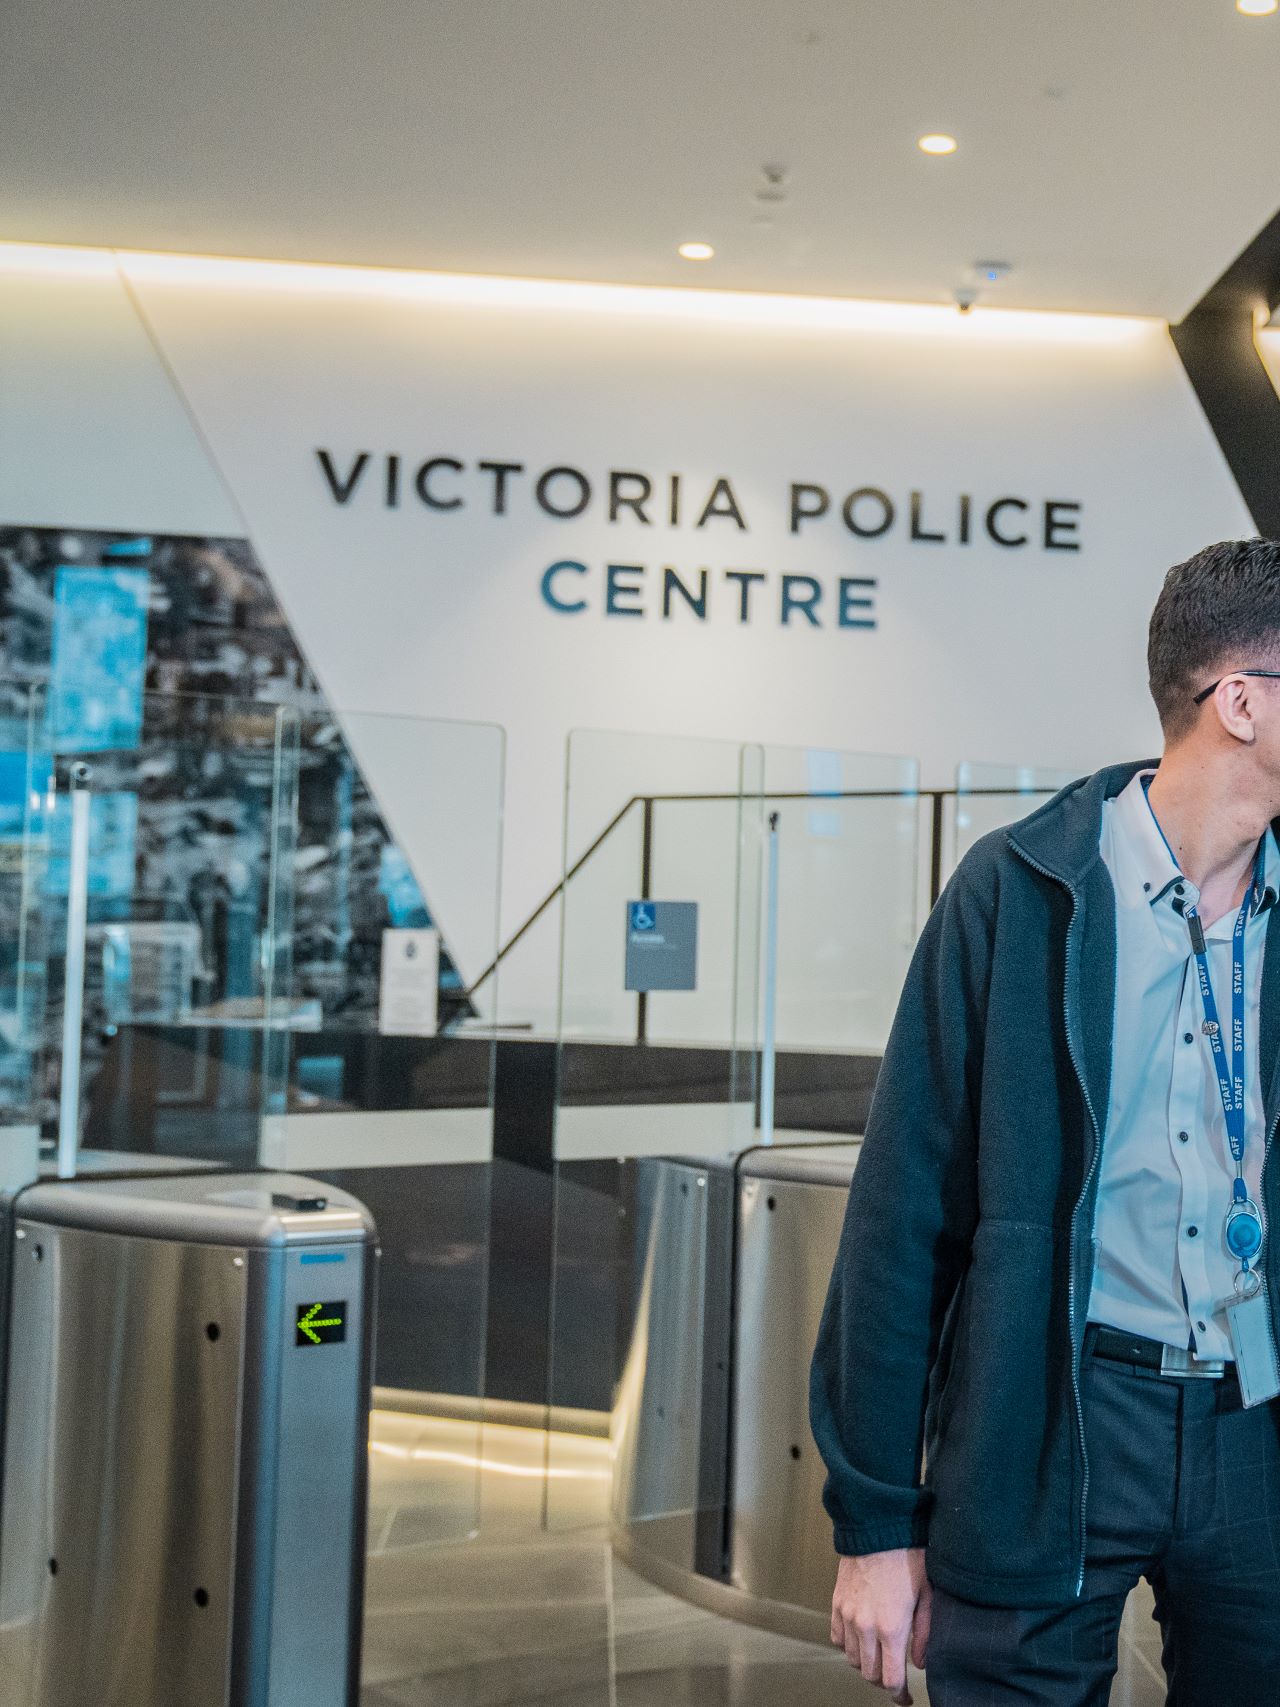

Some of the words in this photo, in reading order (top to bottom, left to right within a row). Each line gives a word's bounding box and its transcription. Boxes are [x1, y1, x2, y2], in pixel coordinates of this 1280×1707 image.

[315, 449, 749, 531] VICTORIA
[789, 483, 1083, 552] POLICE
[539, 559, 879, 630] CENTRE
[1235, 909, 1245, 937] STAFF
[1198, 963, 1210, 997] STAFF
[1233, 961, 1242, 995] STAFF
[1233, 1018, 1243, 1052] STAFF
[1220, 1078, 1233, 1112] STAFF
[1234, 1076, 1243, 1110] STAFF
